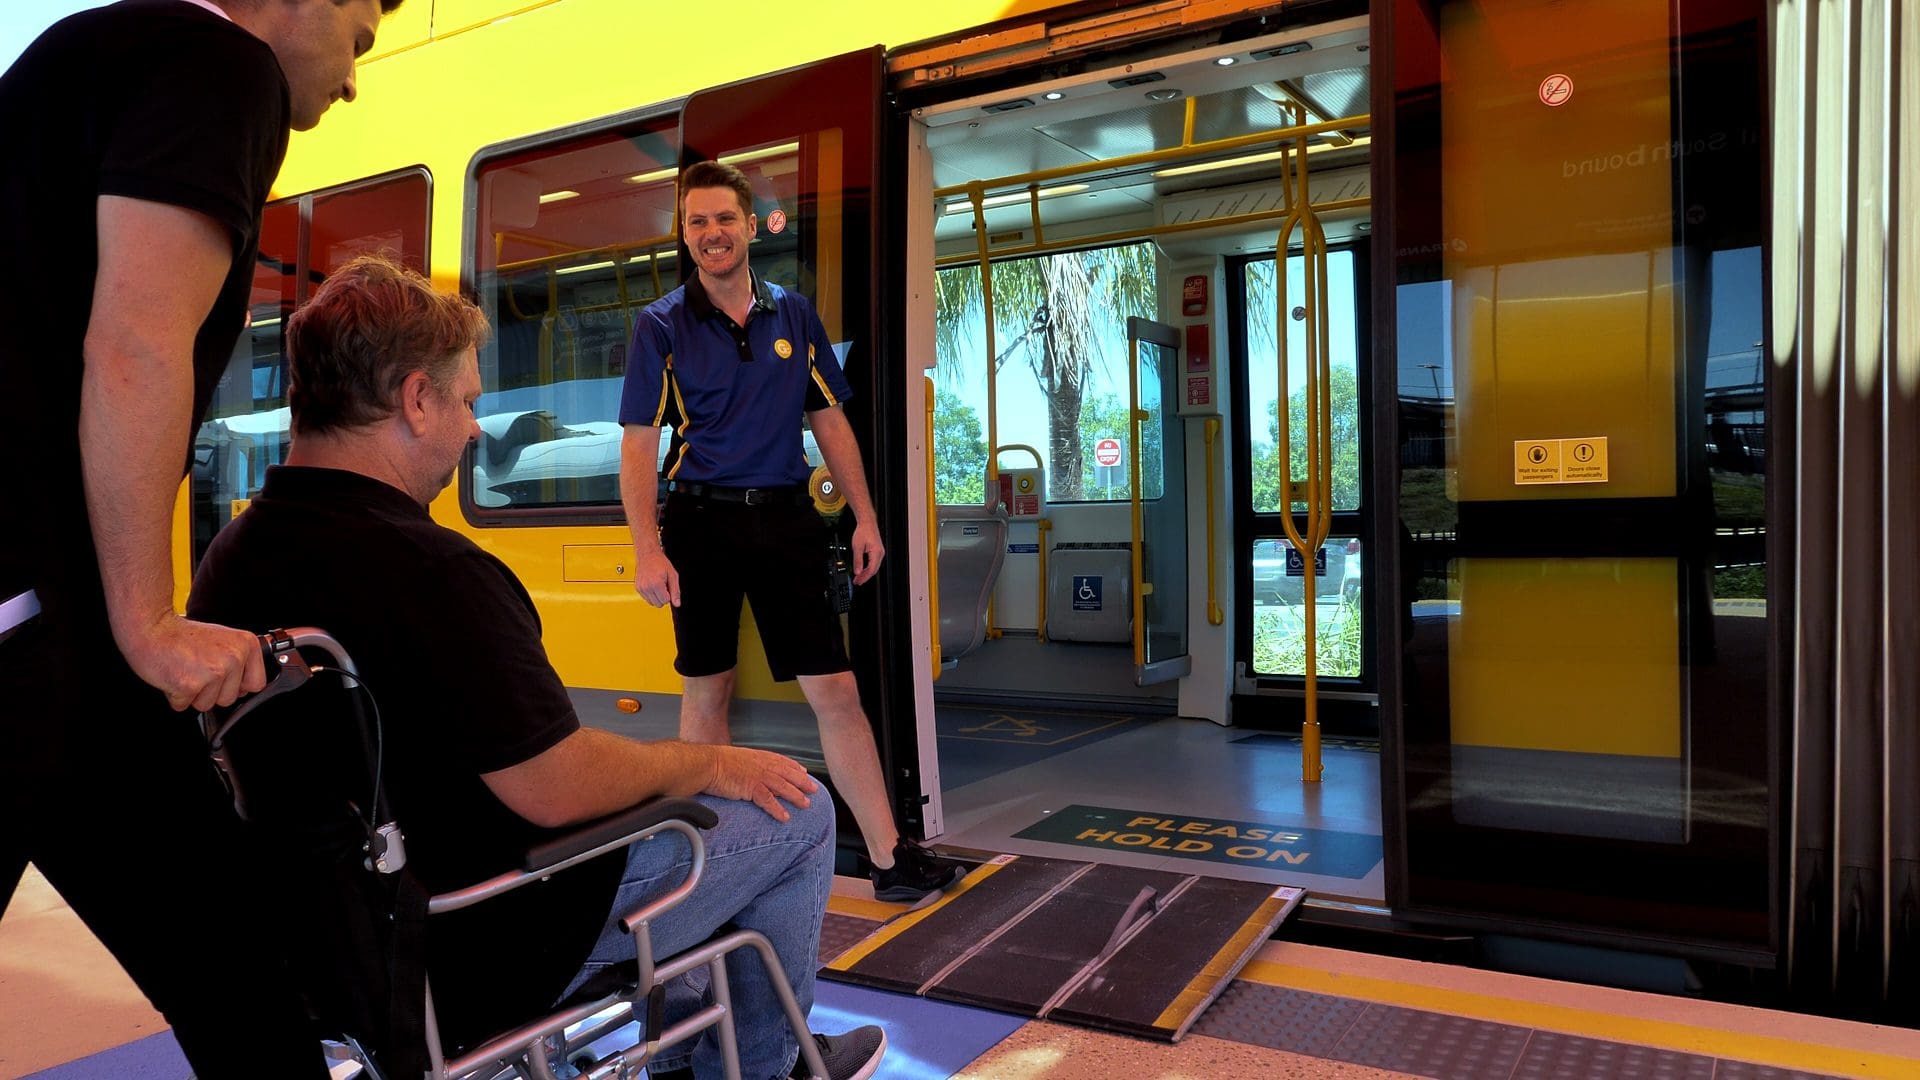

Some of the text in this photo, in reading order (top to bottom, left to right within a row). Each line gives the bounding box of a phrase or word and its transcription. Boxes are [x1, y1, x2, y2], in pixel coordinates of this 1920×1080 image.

[1126, 816, 1305, 844] PLEASE
[1075, 828, 1313, 865] HOLD ON
